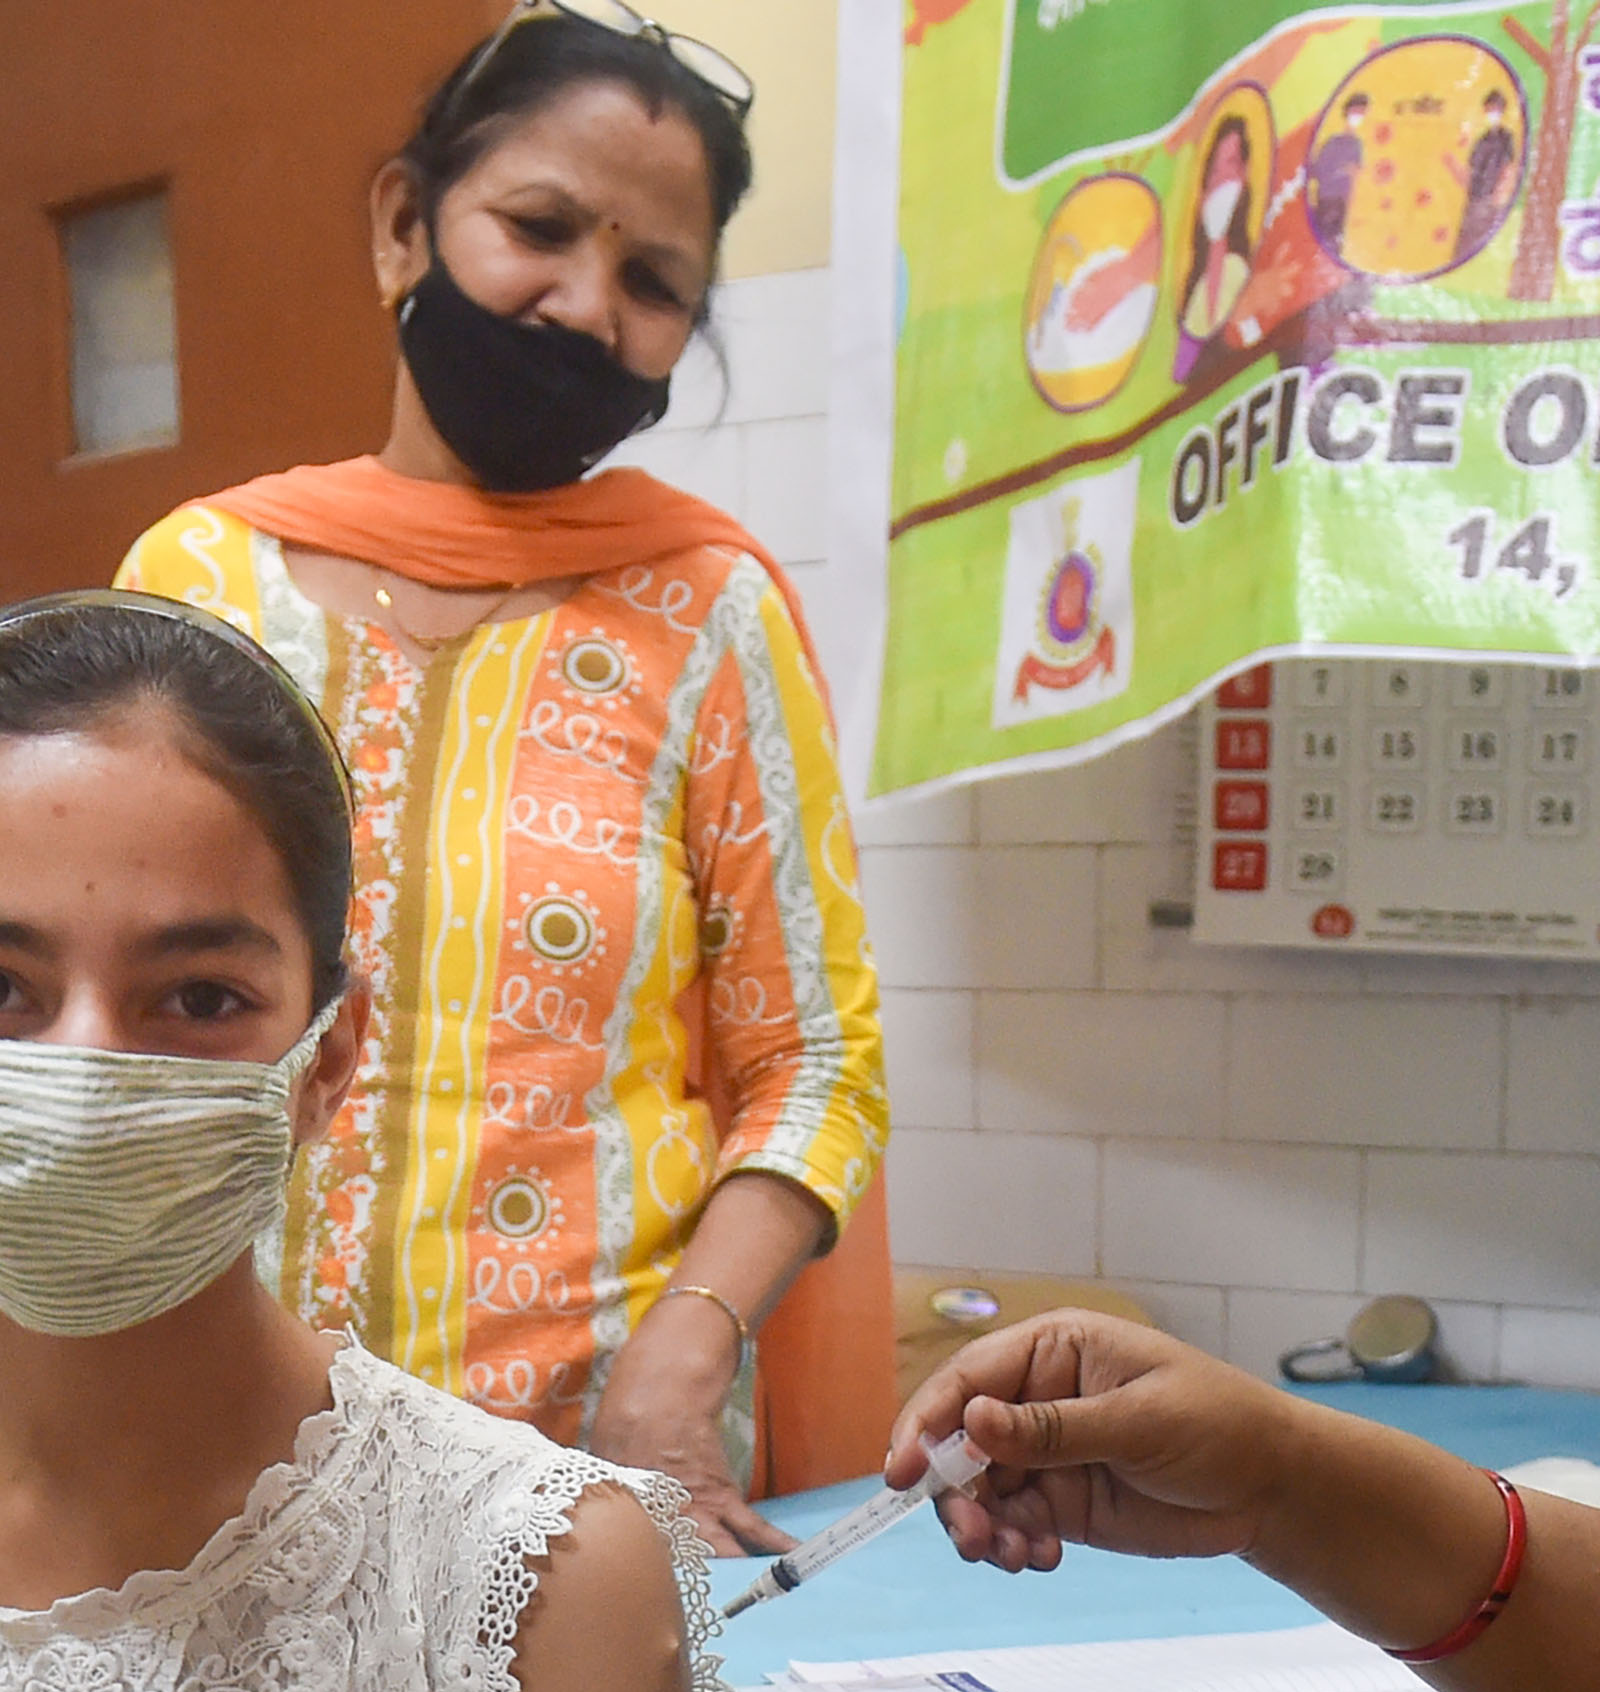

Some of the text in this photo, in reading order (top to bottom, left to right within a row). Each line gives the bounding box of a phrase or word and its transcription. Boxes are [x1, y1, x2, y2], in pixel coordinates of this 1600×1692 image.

[1171, 368, 1466, 526] OFFICE
[1447, 517, 1578, 599] 14,
[1314, 668, 1329, 696] 7
[1545, 668, 1582, 697] 10
[1304, 730, 1337, 758] 14
[1381, 729, 1416, 759] 15
[1461, 730, 1496, 759] 16
[1541, 732, 1577, 761] 17
[1302, 791, 1335, 821] 21
[1378, 794, 1415, 823] 22
[1455, 794, 1494, 824] 23
[1537, 796, 1574, 826] 24
